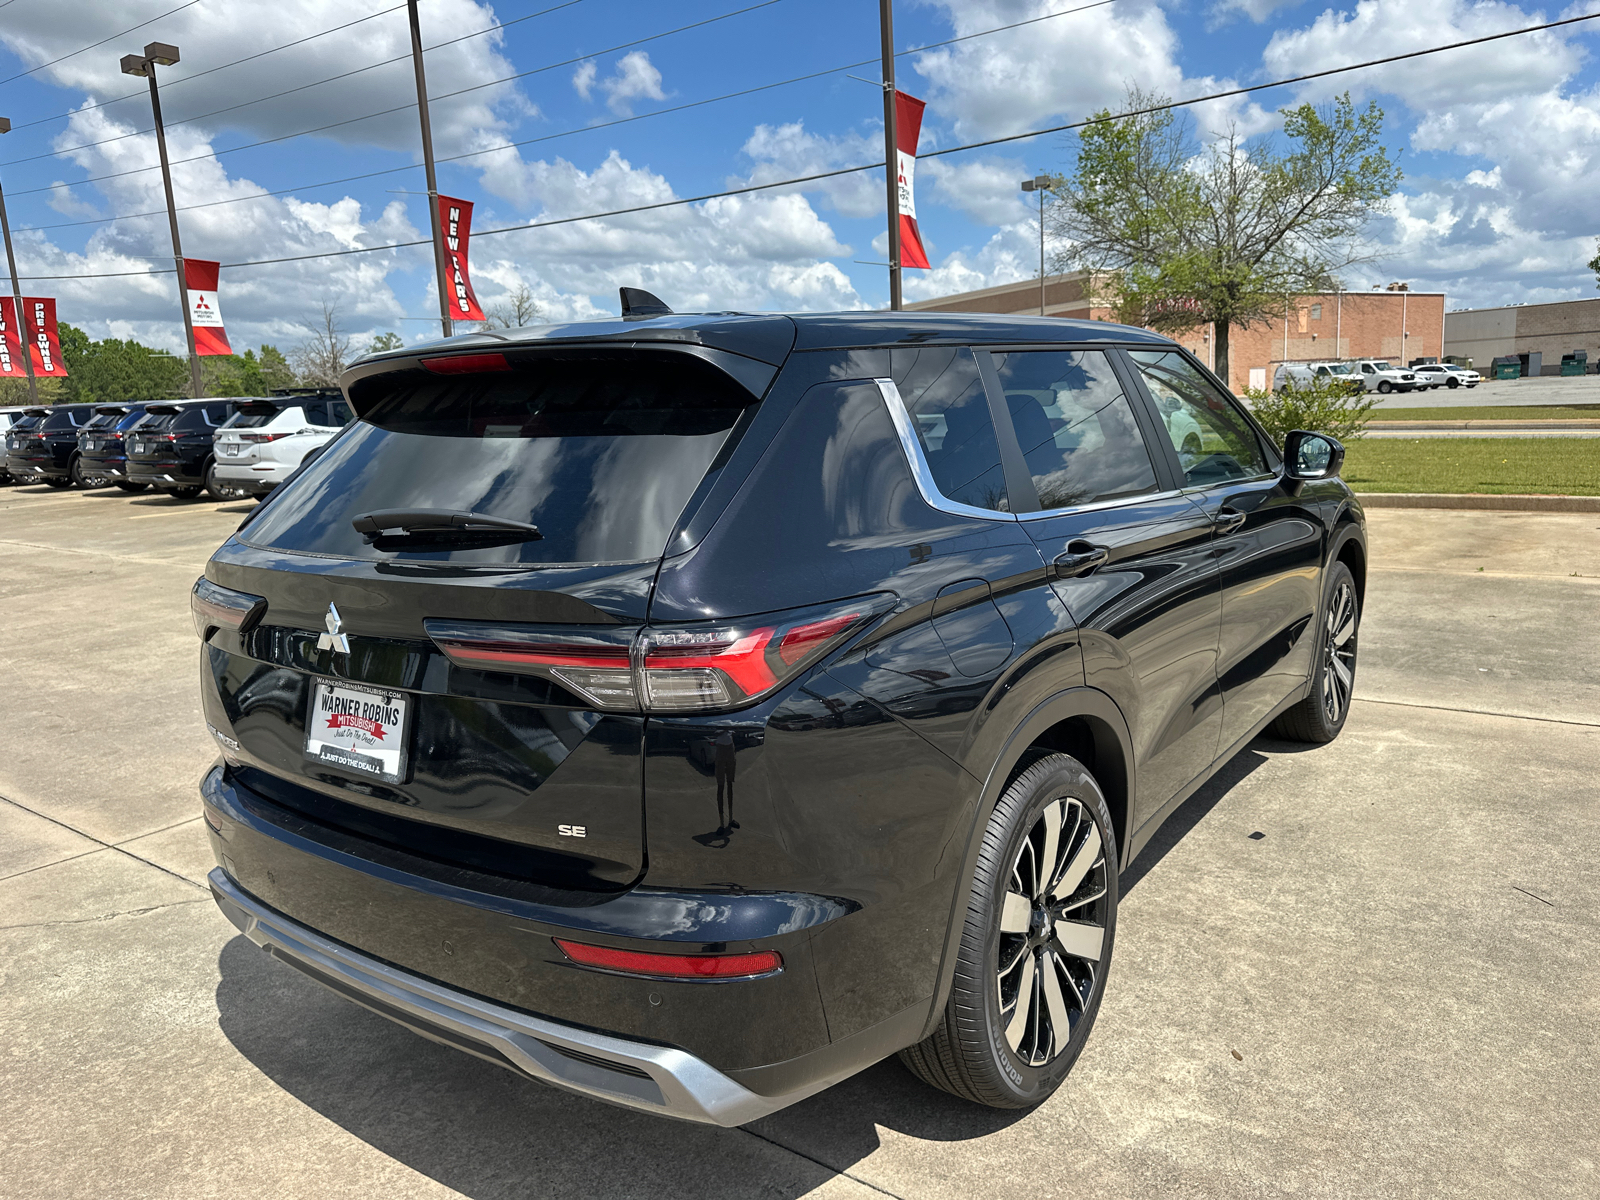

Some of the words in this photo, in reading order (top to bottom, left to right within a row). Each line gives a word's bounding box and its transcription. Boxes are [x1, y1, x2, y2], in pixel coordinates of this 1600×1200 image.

[447, 206, 461, 251] NEW
[452, 256, 470, 312] CARS
[35, 303, 54, 371] PRE-OWNED
[321, 694, 360, 716] WARNER
[363, 702, 400, 726] ROBINS
[337, 715, 376, 732] MITSUBISHI
[334, 729, 346, 738] Just
[346, 729, 353, 737] Do
[325, 755, 339, 763] JUST
[347, 759, 358, 768] THE
[358, 762, 375, 772] DEAL!
[558, 824, 586, 838] SE
[992, 1025, 1023, 1086] ROADIAN
